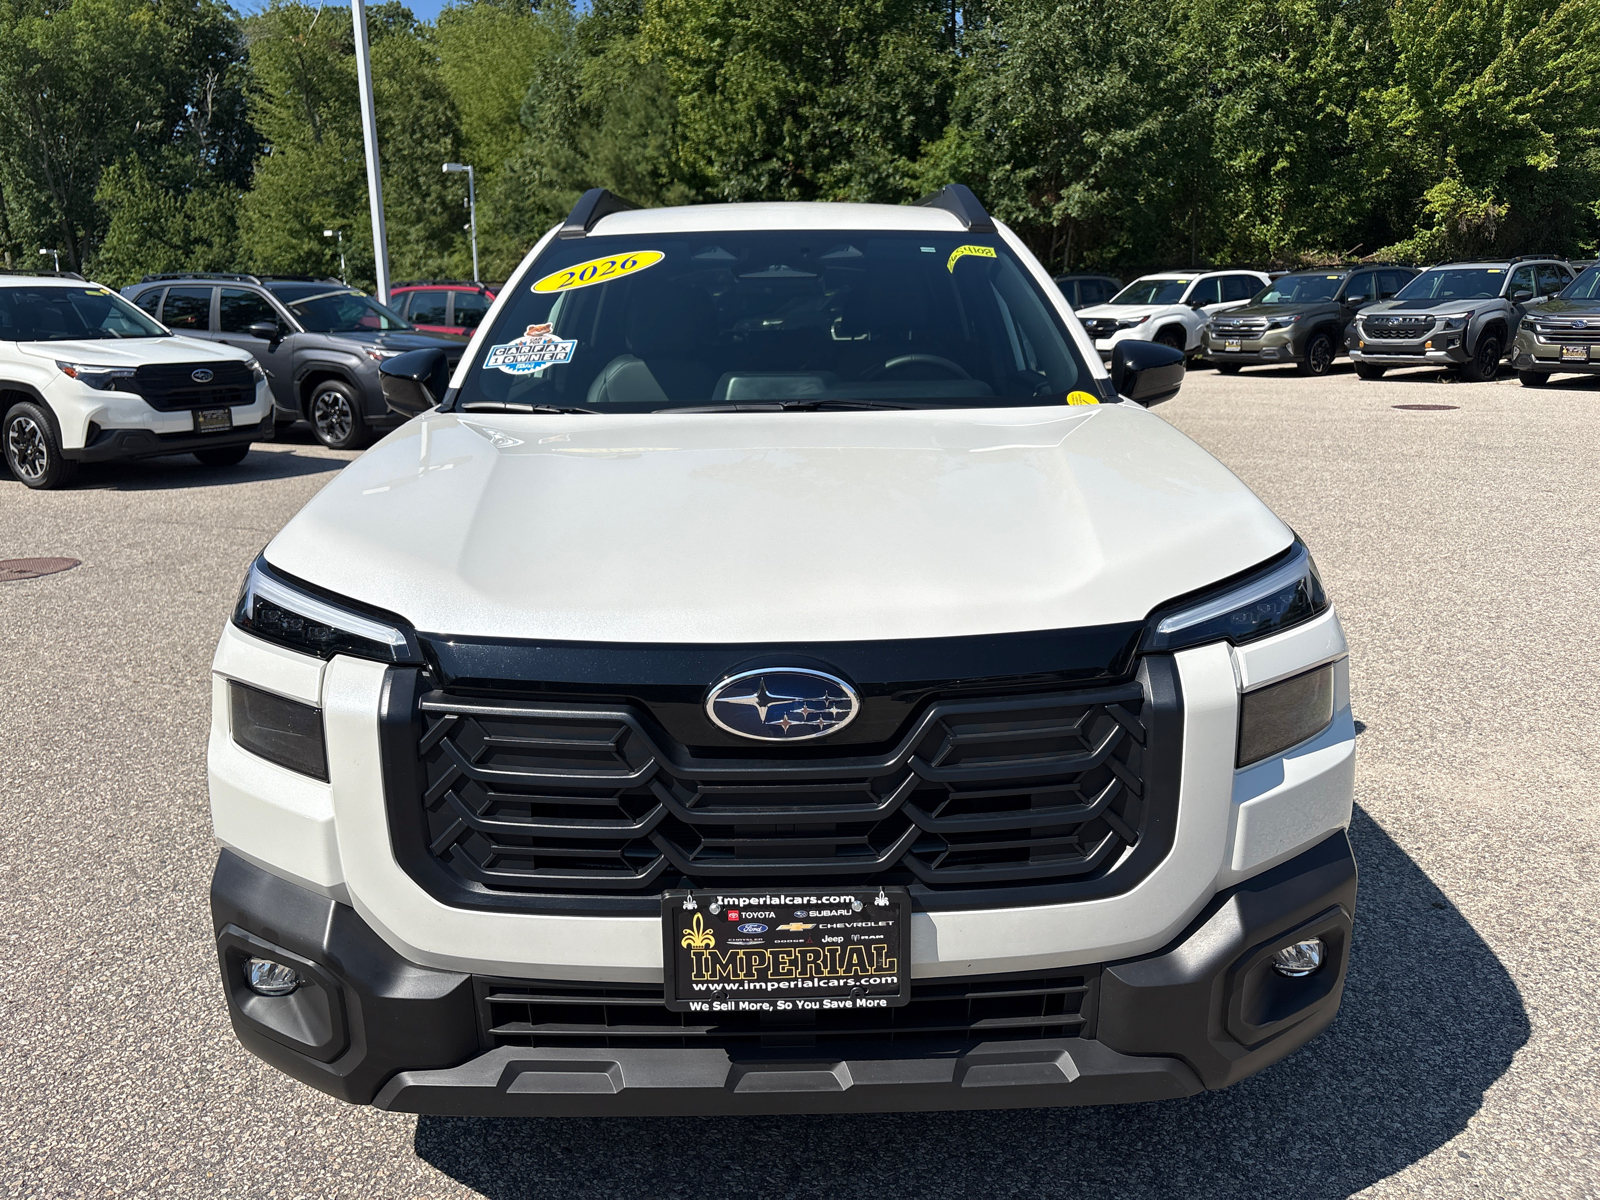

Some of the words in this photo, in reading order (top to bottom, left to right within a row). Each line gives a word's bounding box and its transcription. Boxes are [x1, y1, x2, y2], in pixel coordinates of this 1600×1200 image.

[557, 253, 639, 289] 2026
[494, 345, 569, 356] CARFAX
[504, 352, 567, 363] OWNER
[716, 895, 855, 907] Imperialcars.com
[741, 911, 776, 919] TOYOTA
[809, 909, 852, 917] SUBARU
[819, 920, 895, 929] CHEVROLET
[821, 935, 844, 943] Jeep
[691, 944, 897, 980] IMPERIAL
[692, 976, 898, 991] www.imperialcars.com
[689, 1002, 709, 1011] We
[713, 1001, 735, 1010] Sell
[739, 1001, 773, 1011] More,
[777, 1000, 793, 1010] So
[796, 1000, 820, 1009] You
[823, 999, 853, 1008] Save
[856, 998, 887, 1007] More
